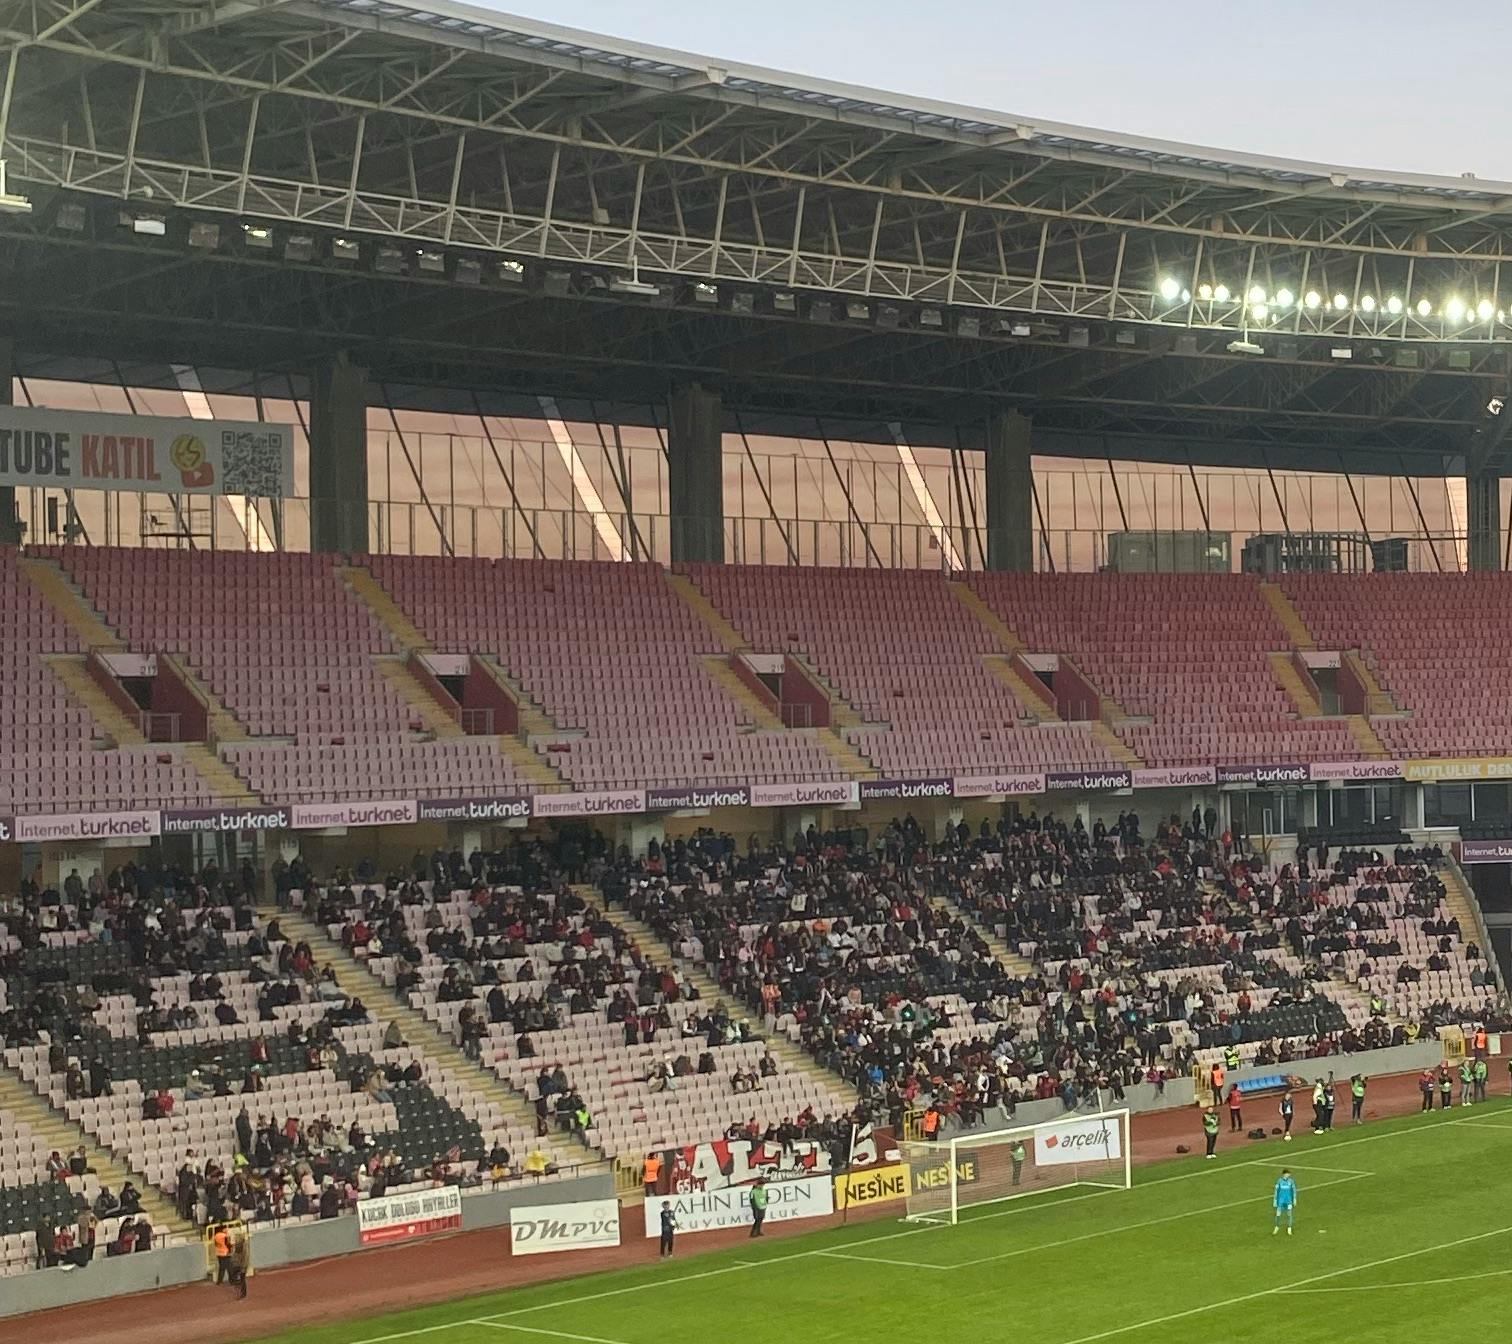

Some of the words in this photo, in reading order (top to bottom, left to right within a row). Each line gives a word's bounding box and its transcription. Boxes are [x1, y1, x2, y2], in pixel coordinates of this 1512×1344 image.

[81, 433, 161, 481] KATIL
[1169, 770, 1213, 784] turknet
[1256, 767, 1308, 781] turknet
[1352, 763, 1401, 777] turknet
[995, 777, 1042, 793] turknet
[1084, 773, 1129, 788] turknet
[796, 786, 847, 802] turknet
[901, 781, 951, 797] turknet
[584, 796, 642, 811] turknet
[692, 789, 748, 806] turknet
[349, 805, 412, 822] turknet
[469, 800, 530, 816] turknet
[80, 816, 151, 836] turknet
[221, 810, 288, 829] turknet
[1061, 1129, 1112, 1150] arçelik
[674, 1190, 729, 1216] AHİN
[740, 1183, 812, 1205] EDEN
